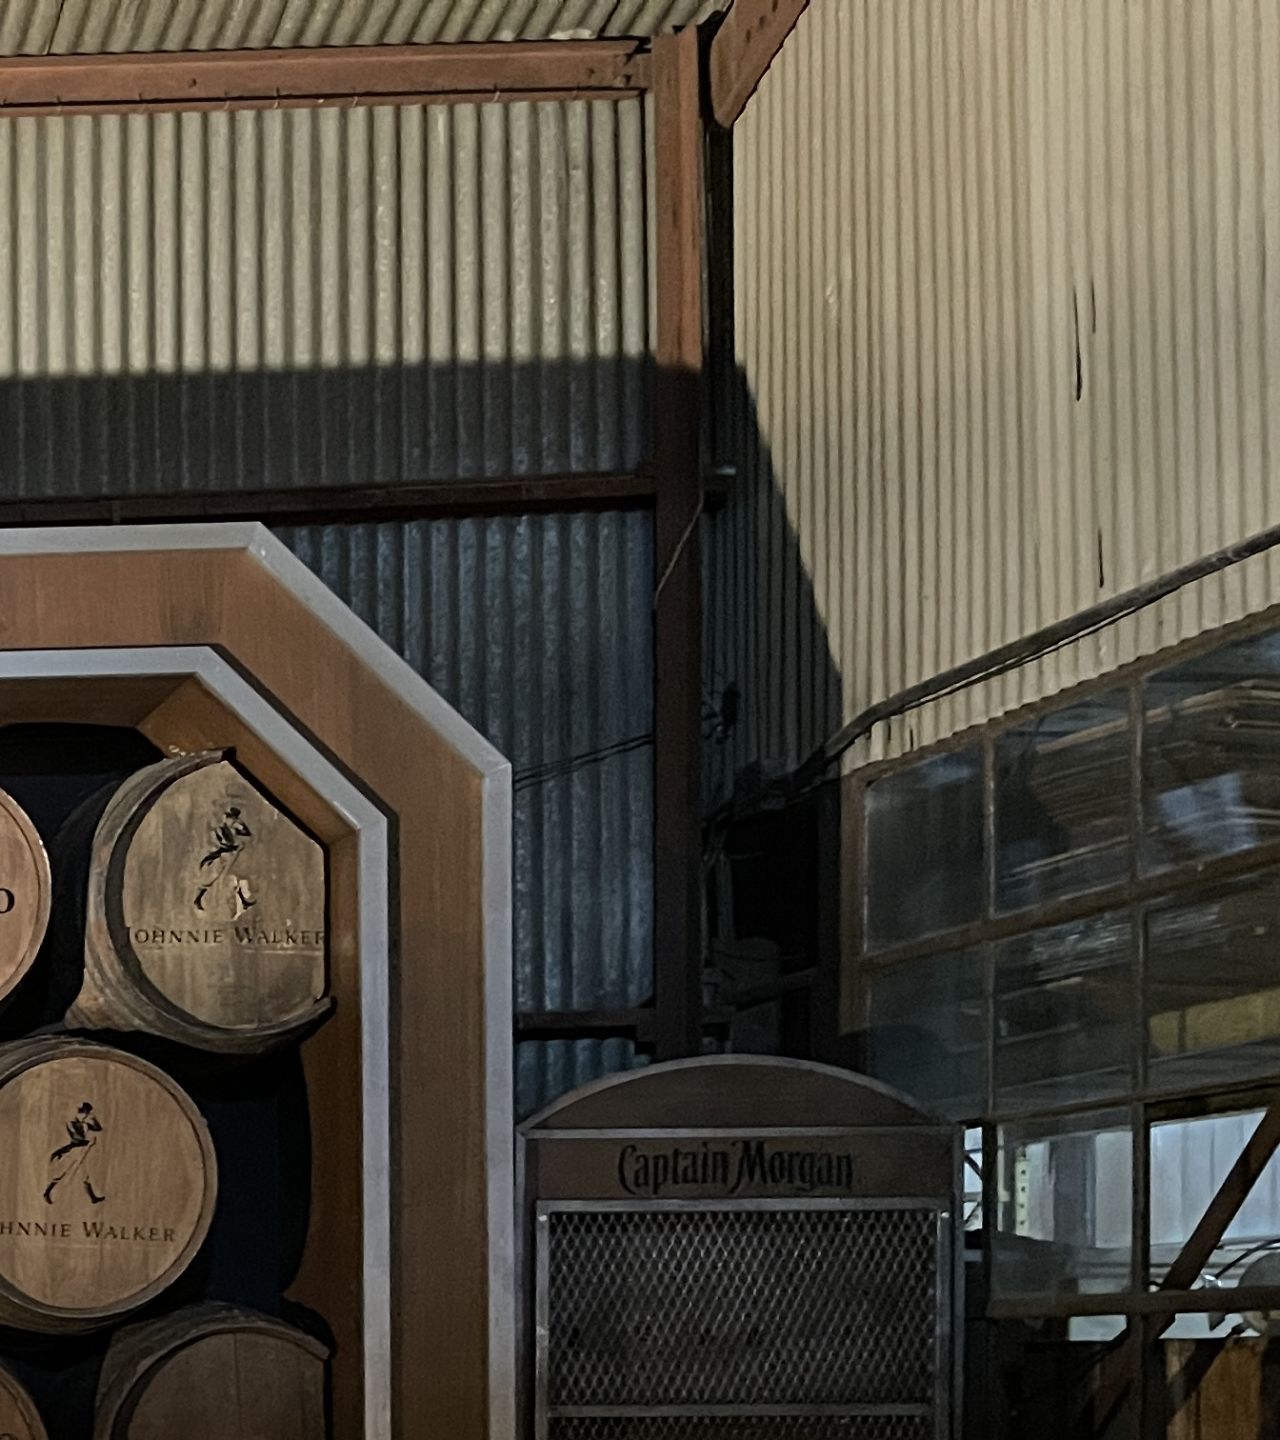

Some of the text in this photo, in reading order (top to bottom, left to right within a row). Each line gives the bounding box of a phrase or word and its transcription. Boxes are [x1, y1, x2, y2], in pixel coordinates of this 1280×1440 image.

[133, 928, 224, 945] OHNNIE
[617, 1139, 854, 1195] Captain Morgan
[83, 1221, 177, 1243] WALKER
